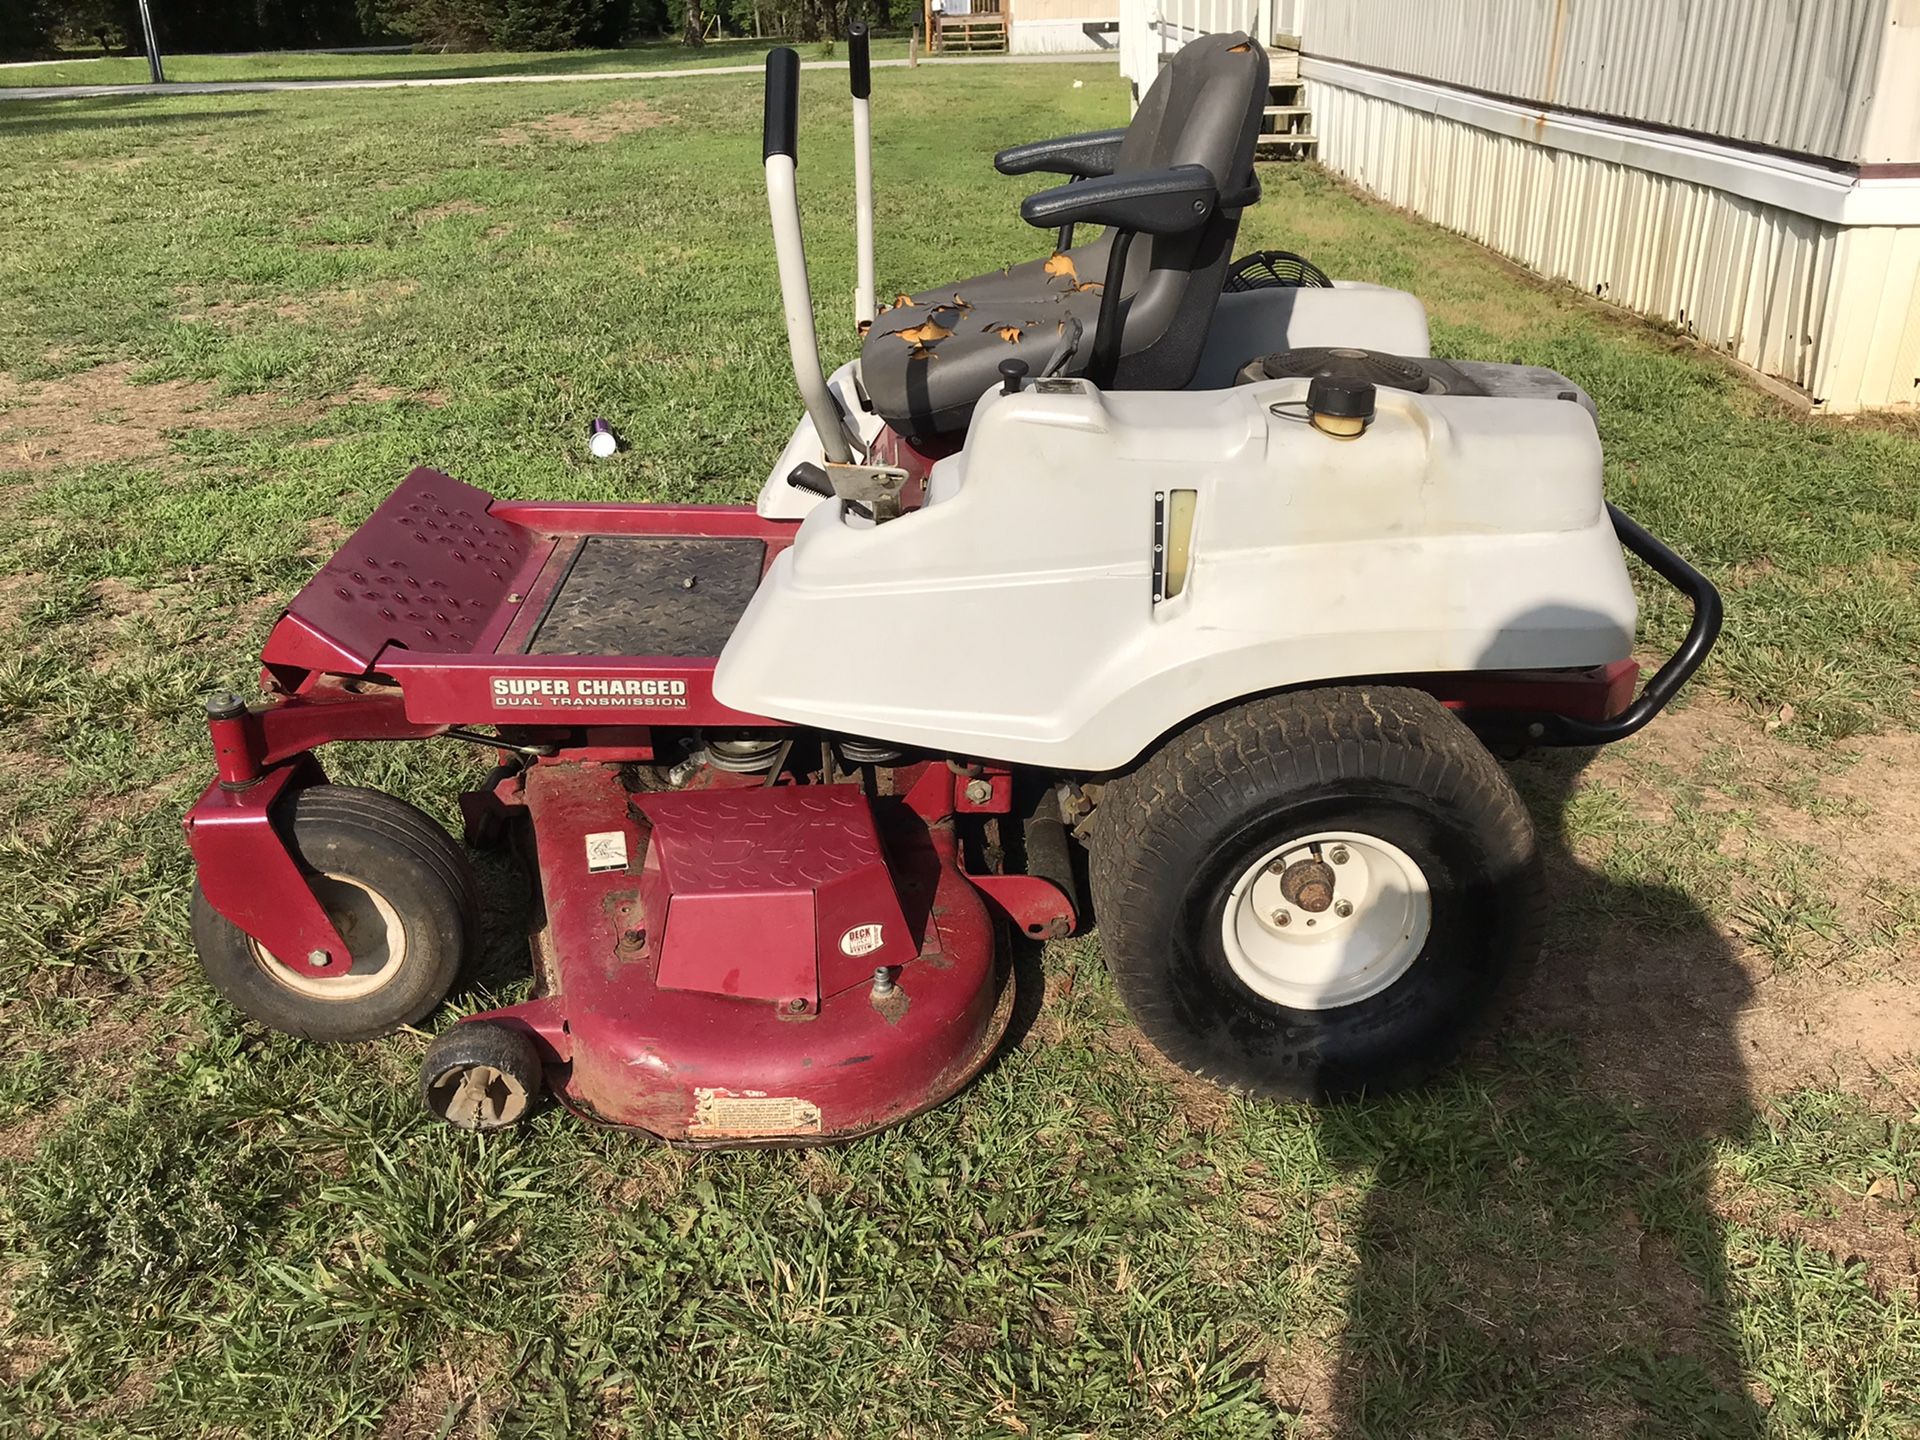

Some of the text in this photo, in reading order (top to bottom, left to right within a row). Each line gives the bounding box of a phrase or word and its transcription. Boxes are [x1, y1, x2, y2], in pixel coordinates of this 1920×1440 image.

[493, 679, 686, 695] SUPER CHARGED
[495, 697, 687, 706] DUAL TRANSMISSION
[849, 928, 871, 941] DECK
